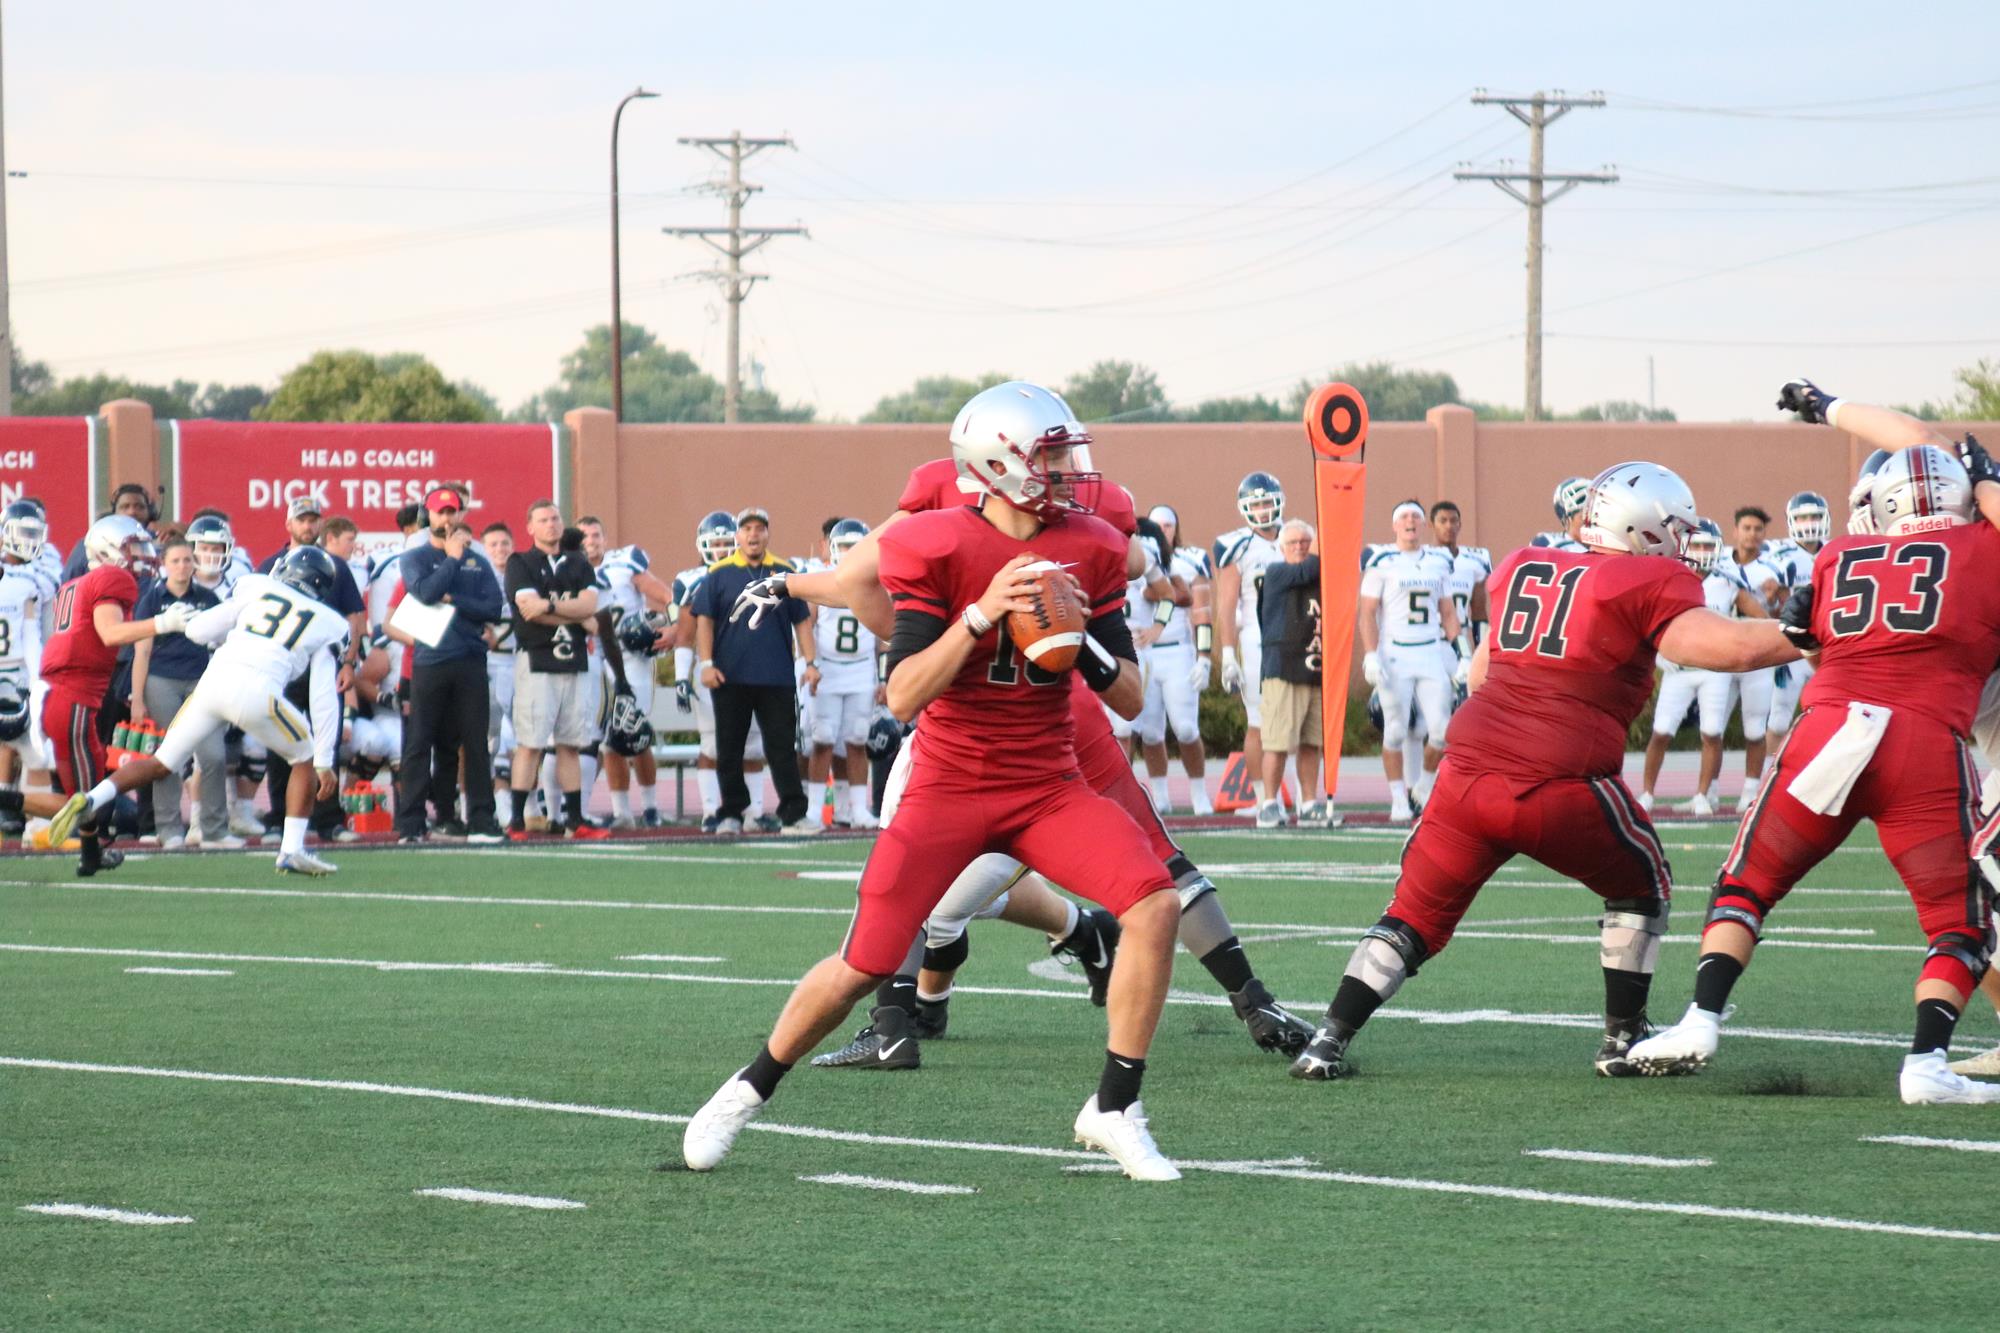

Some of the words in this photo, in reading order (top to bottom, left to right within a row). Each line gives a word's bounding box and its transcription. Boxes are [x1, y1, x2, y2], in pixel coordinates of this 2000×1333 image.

[0, 450, 34, 469] CH
[301, 449, 357, 468] HEAD
[363, 449, 434, 468] COACH
[248, 479, 330, 509] DICK
[340, 479, 483, 509] TRESL
[1901, 517, 1953, 534] Riddell
[1829, 541, 1951, 638] 53
[245, 591, 316, 652] 31
[1407, 591, 1430, 625] 5
[1497, 560, 1590, 660] 61
[835, 616, 859, 654] 8
